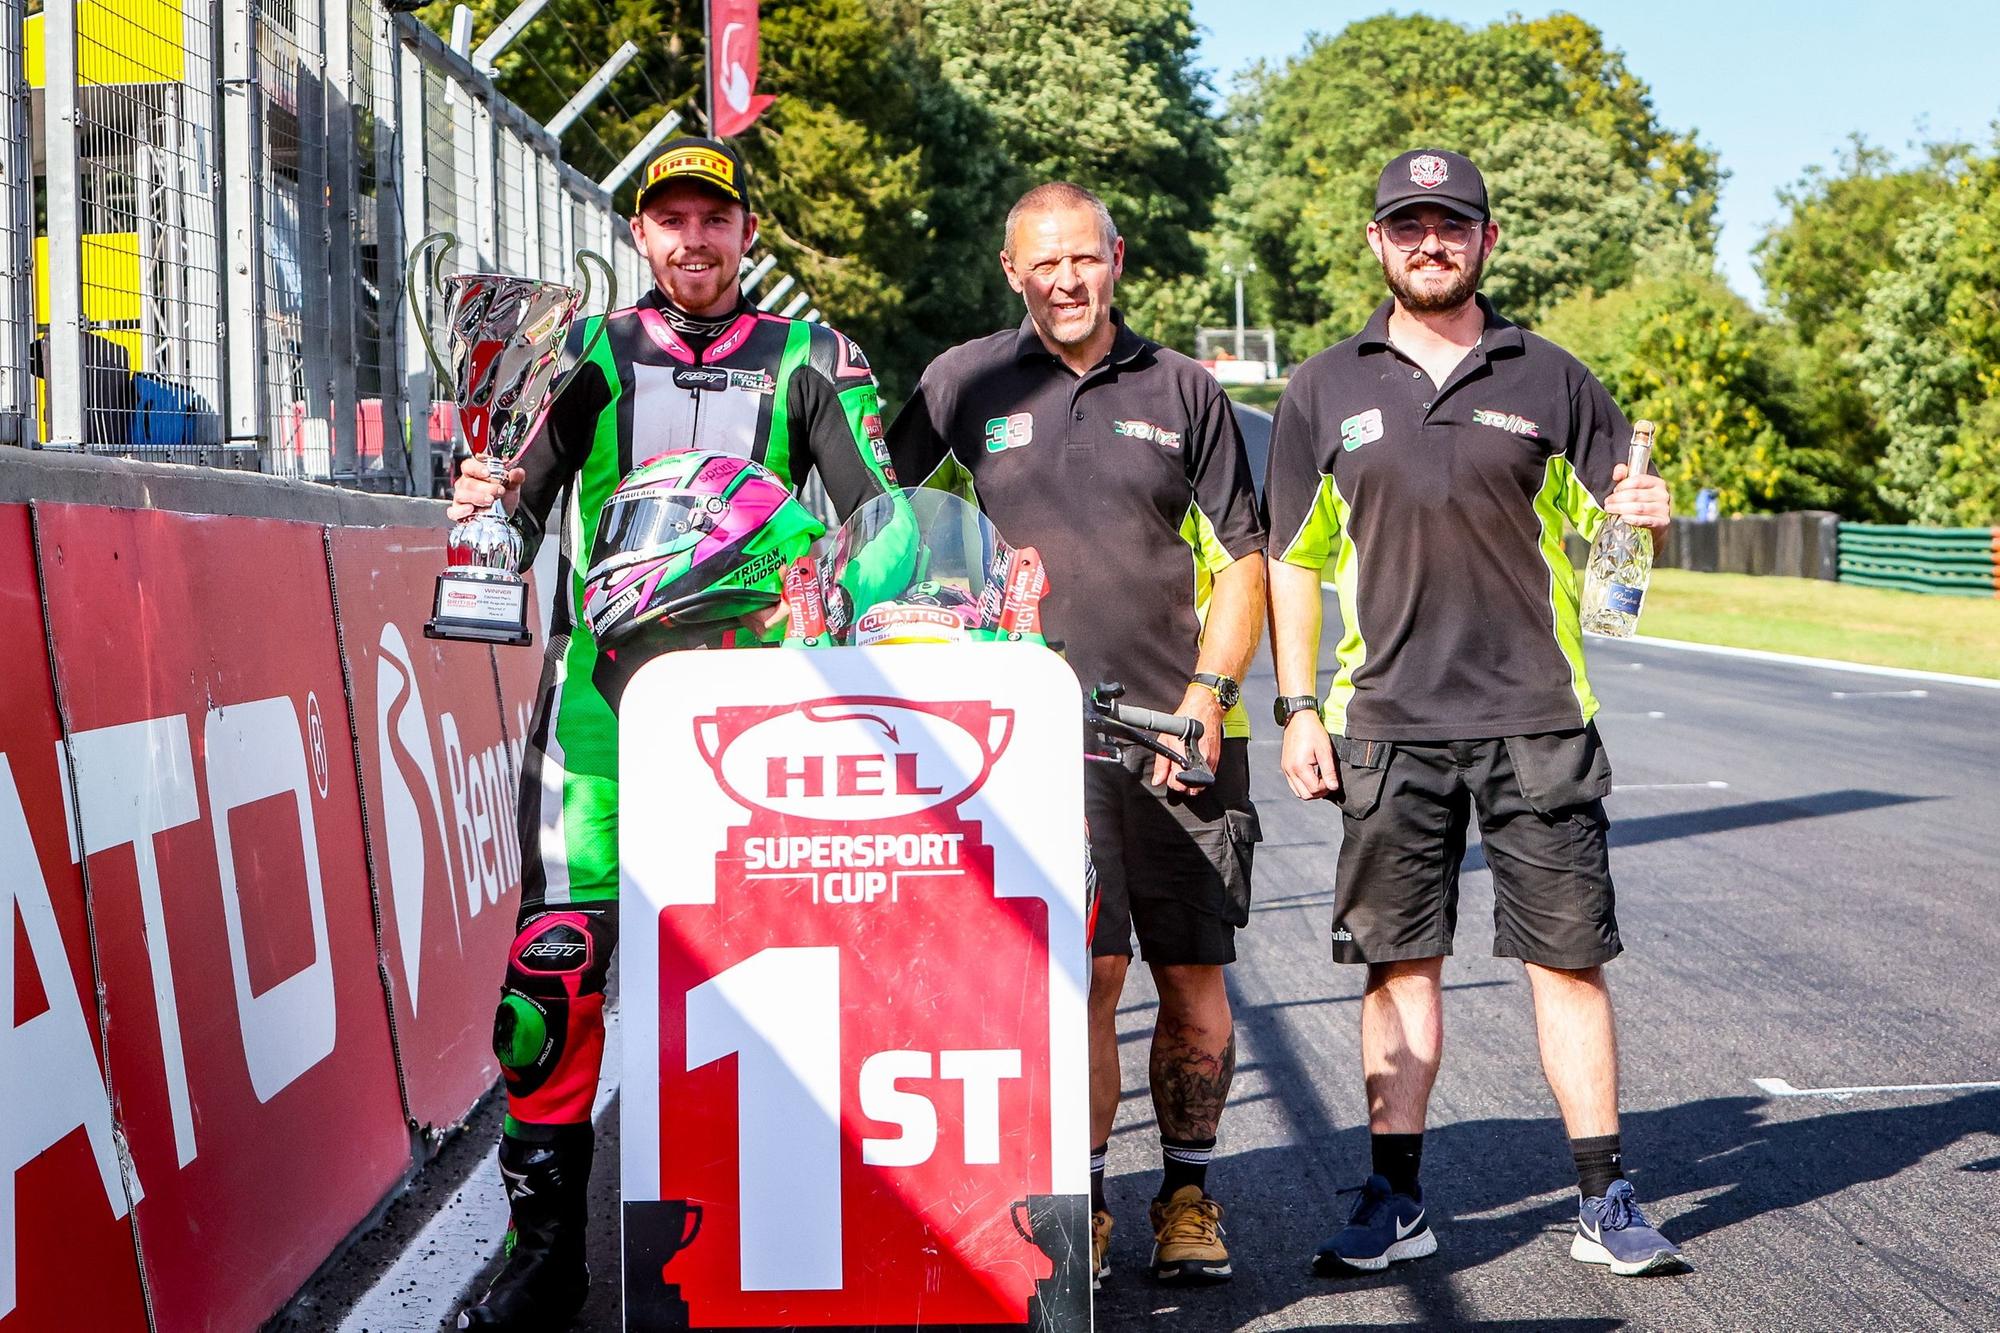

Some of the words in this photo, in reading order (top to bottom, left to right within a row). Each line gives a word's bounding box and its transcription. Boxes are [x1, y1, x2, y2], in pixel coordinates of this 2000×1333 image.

[711, 329, 740, 356] RST
[676, 371, 727, 383] RST
[985, 412, 1034, 453] 33
[1340, 407, 1385, 452] 33
[699, 461, 738, 483] sprint
[734, 548, 780, 581] TRISTAN
[743, 554, 788, 589] HUDSON
[785, 565, 804, 592] HGV
[803, 576, 821, 620] Walkers
[1004, 570, 1029, 613] Walkers
[594, 587, 641, 634] SOMERSCALES
[789, 593, 809, 638] Training
[863, 609, 954, 629] QUATTRO
[1014, 603, 1037, 633] HGV
[765, 752, 944, 798] HEL
[744, 833, 963, 869] SUPERSPORT
[823, 872, 888, 904] CUP
[522, 942, 586, 958] RST
[510, 988, 547, 1015] SPECIFICATION
